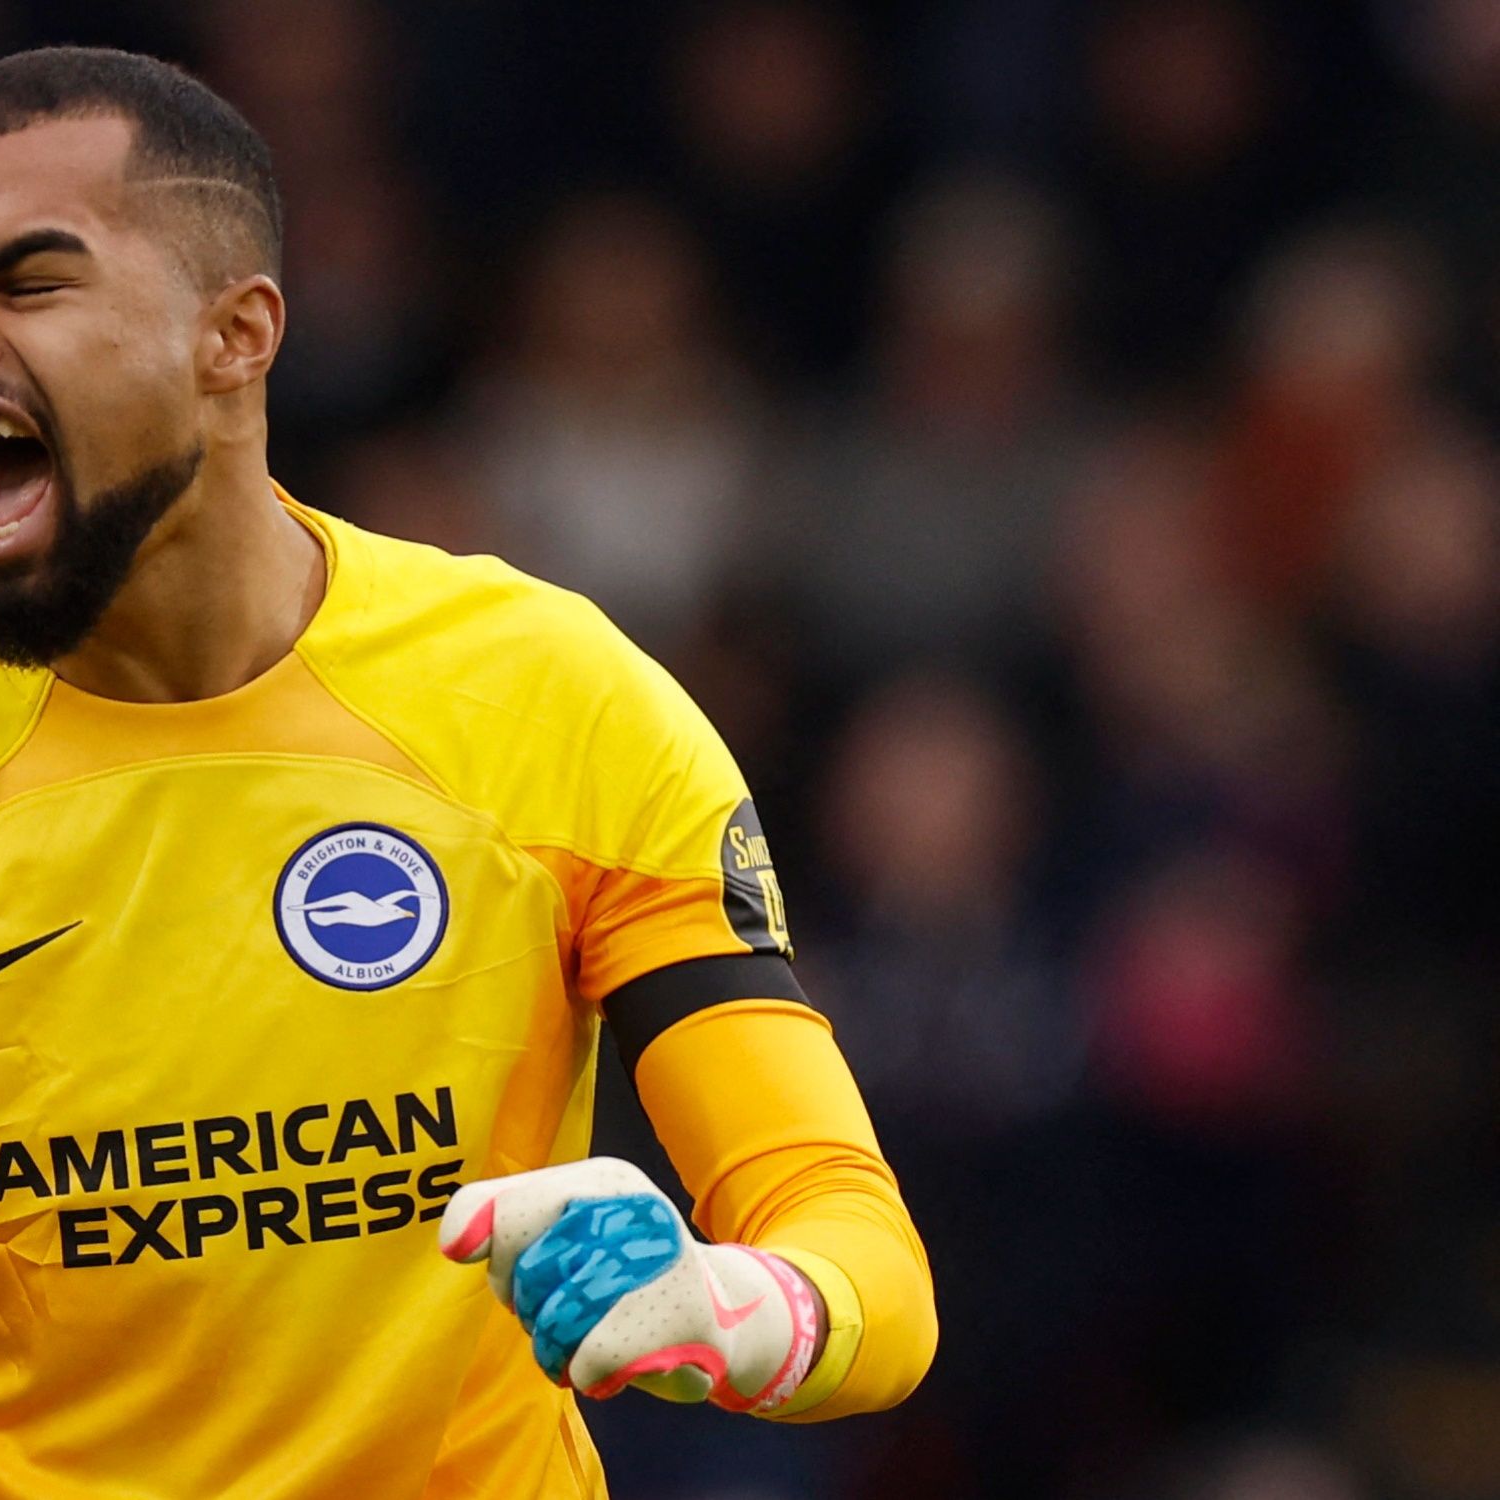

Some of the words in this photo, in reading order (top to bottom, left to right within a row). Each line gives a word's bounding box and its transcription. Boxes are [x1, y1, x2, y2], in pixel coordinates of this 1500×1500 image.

[297, 837, 366, 880] BRIGHTON
[373, 839, 385, 851] &
[389, 847, 424, 877] HOVE
[334, 963, 395, 979] ALBION
[58, 1159, 464, 1269] EXPRESS
